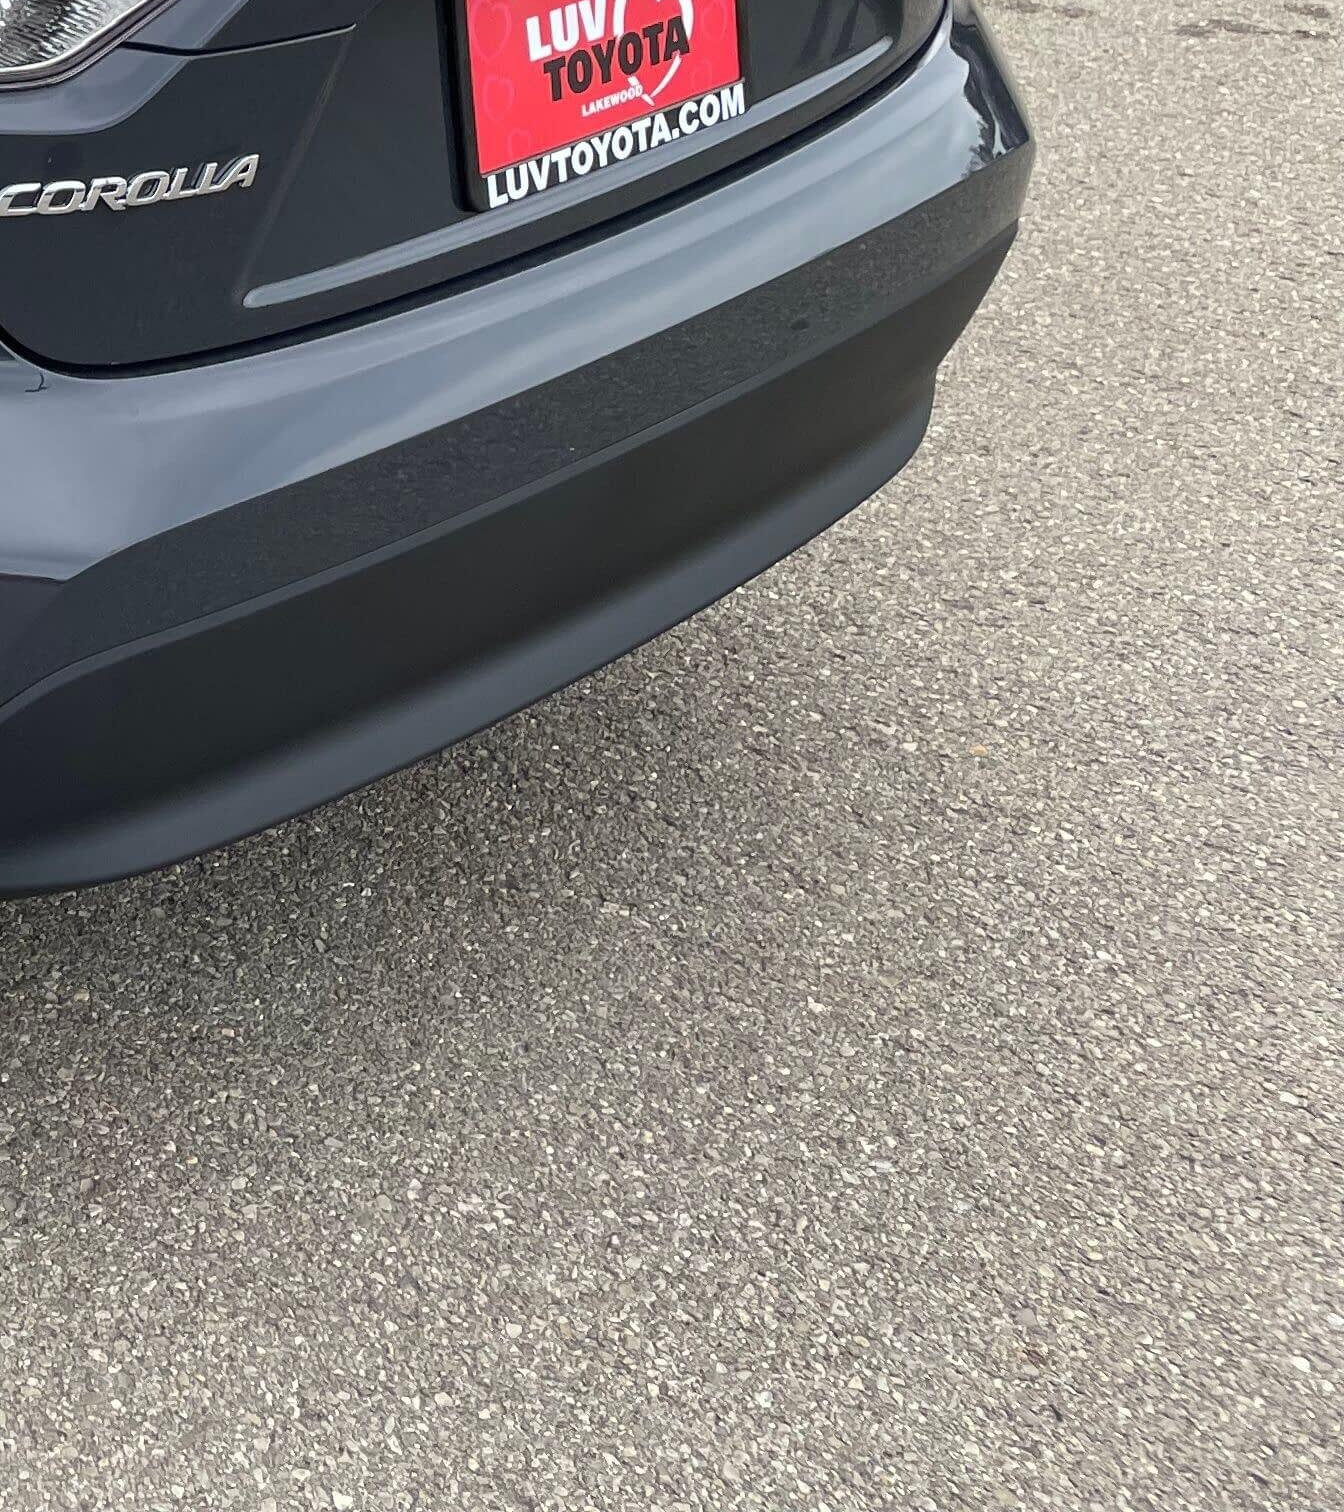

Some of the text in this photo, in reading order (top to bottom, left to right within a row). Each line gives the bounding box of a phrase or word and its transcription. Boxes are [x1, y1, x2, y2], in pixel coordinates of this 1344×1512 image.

[543, 15, 690, 102] TOYOTA
[581, 83, 645, 118] LAKEWOOD
[487, 82, 746, 209] LUVTOYOTA.COM
